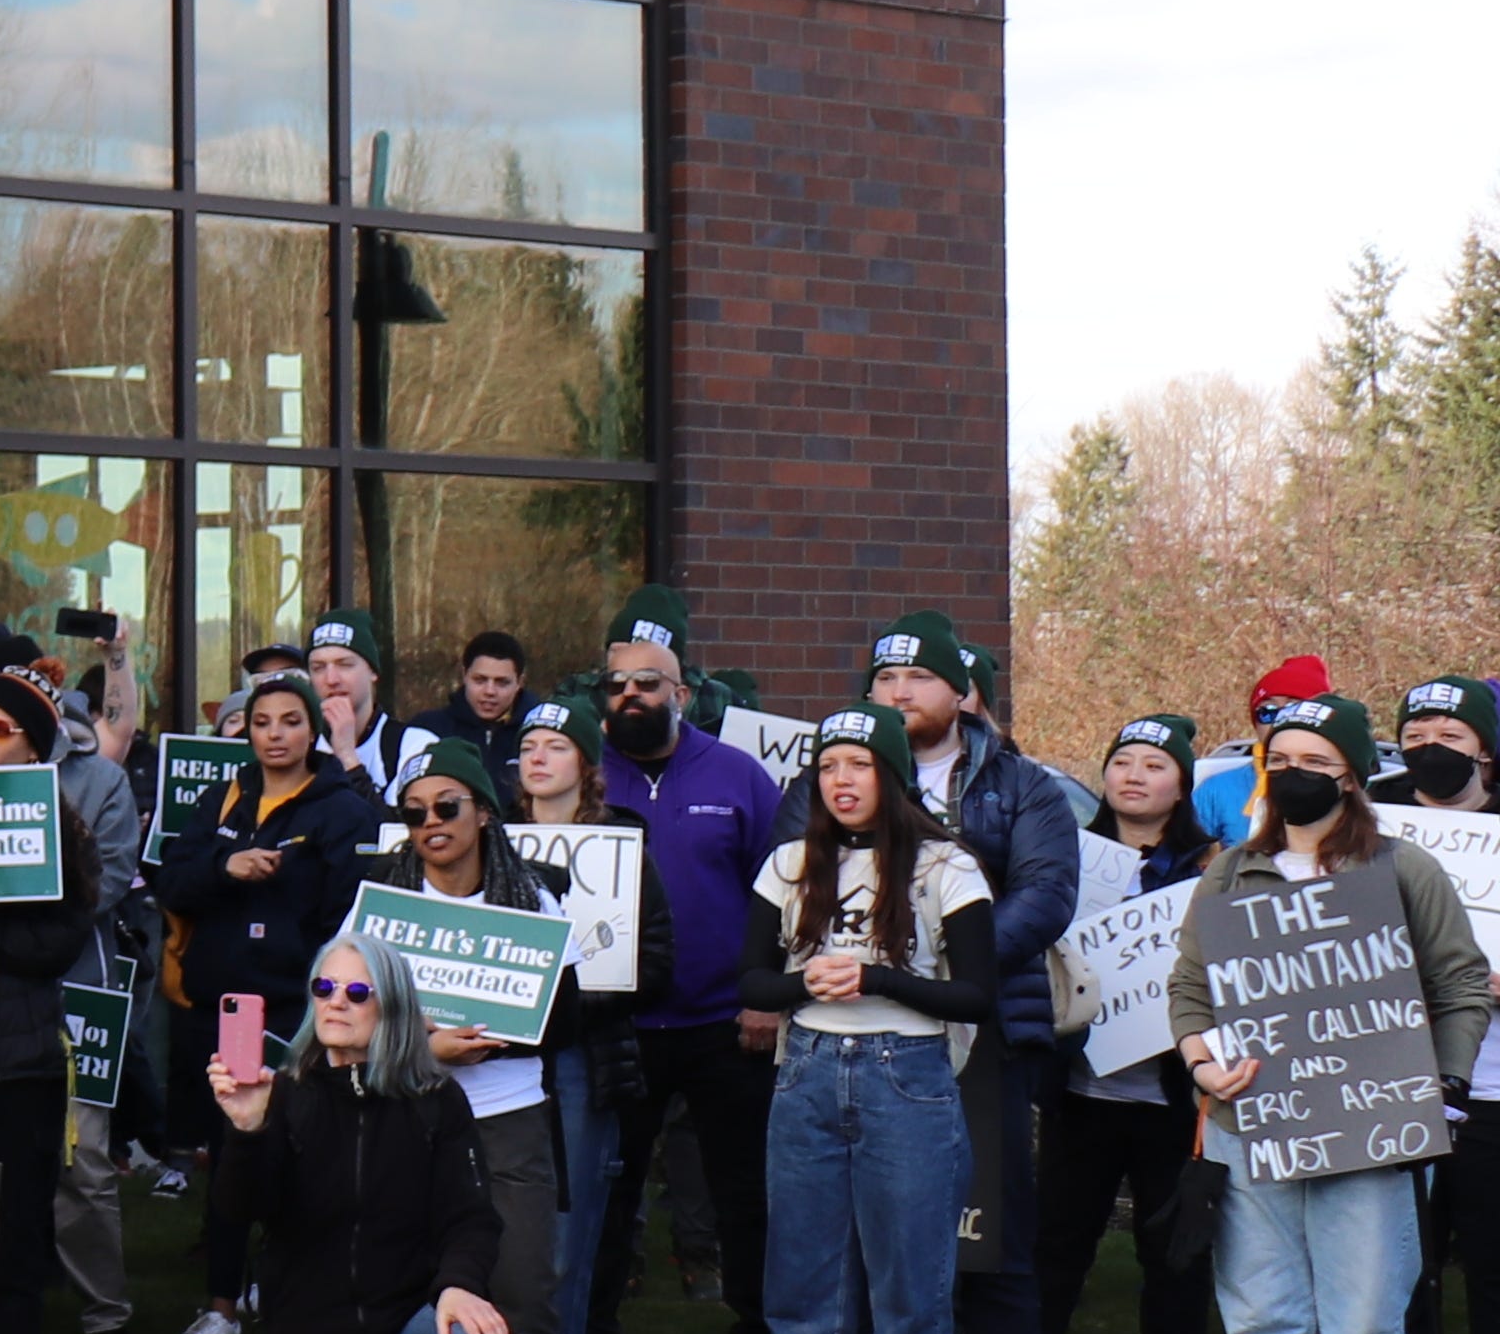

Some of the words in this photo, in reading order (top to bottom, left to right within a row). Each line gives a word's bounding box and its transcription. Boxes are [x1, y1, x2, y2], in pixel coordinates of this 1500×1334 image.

[313, 623, 354, 639] REI
[631, 619, 673, 647] REI
[874, 634, 921, 657] REI
[1407, 683, 1464, 703] REI
[1408, 700, 1457, 713] UNION
[821, 712, 876, 735] REI
[1277, 701, 1334, 724] REI
[1120, 720, 1171, 741] REI
[171, 758, 218, 781] REI:
[174, 784, 197, 805] to
[1230, 880, 1351, 940] THE
[1078, 897, 1172, 956] NION
[362, 914, 427, 948] REI:
[430, 926, 475, 956] It's
[482, 934, 554, 968] Time
[1117, 927, 1182, 971] STRO
[412, 959, 534, 998] egotiate.
[1206, 924, 1415, 1009] MOUNTAINS
[1090, 980, 1161, 1026] UNIO
[84, 1026, 108, 1048] to
[1221, 1013, 1290, 1060] ARE
[1307, 998, 1426, 1044] CALLING
[75, 1053, 111, 1079] RE
[1290, 1054, 1349, 1082] AND
[1235, 1089, 1312, 1132] ERIC
[1340, 1075, 1441, 1112] ARTZ
[1250, 1130, 1345, 1181] MUST
[1366, 1120, 1430, 1164] GO
